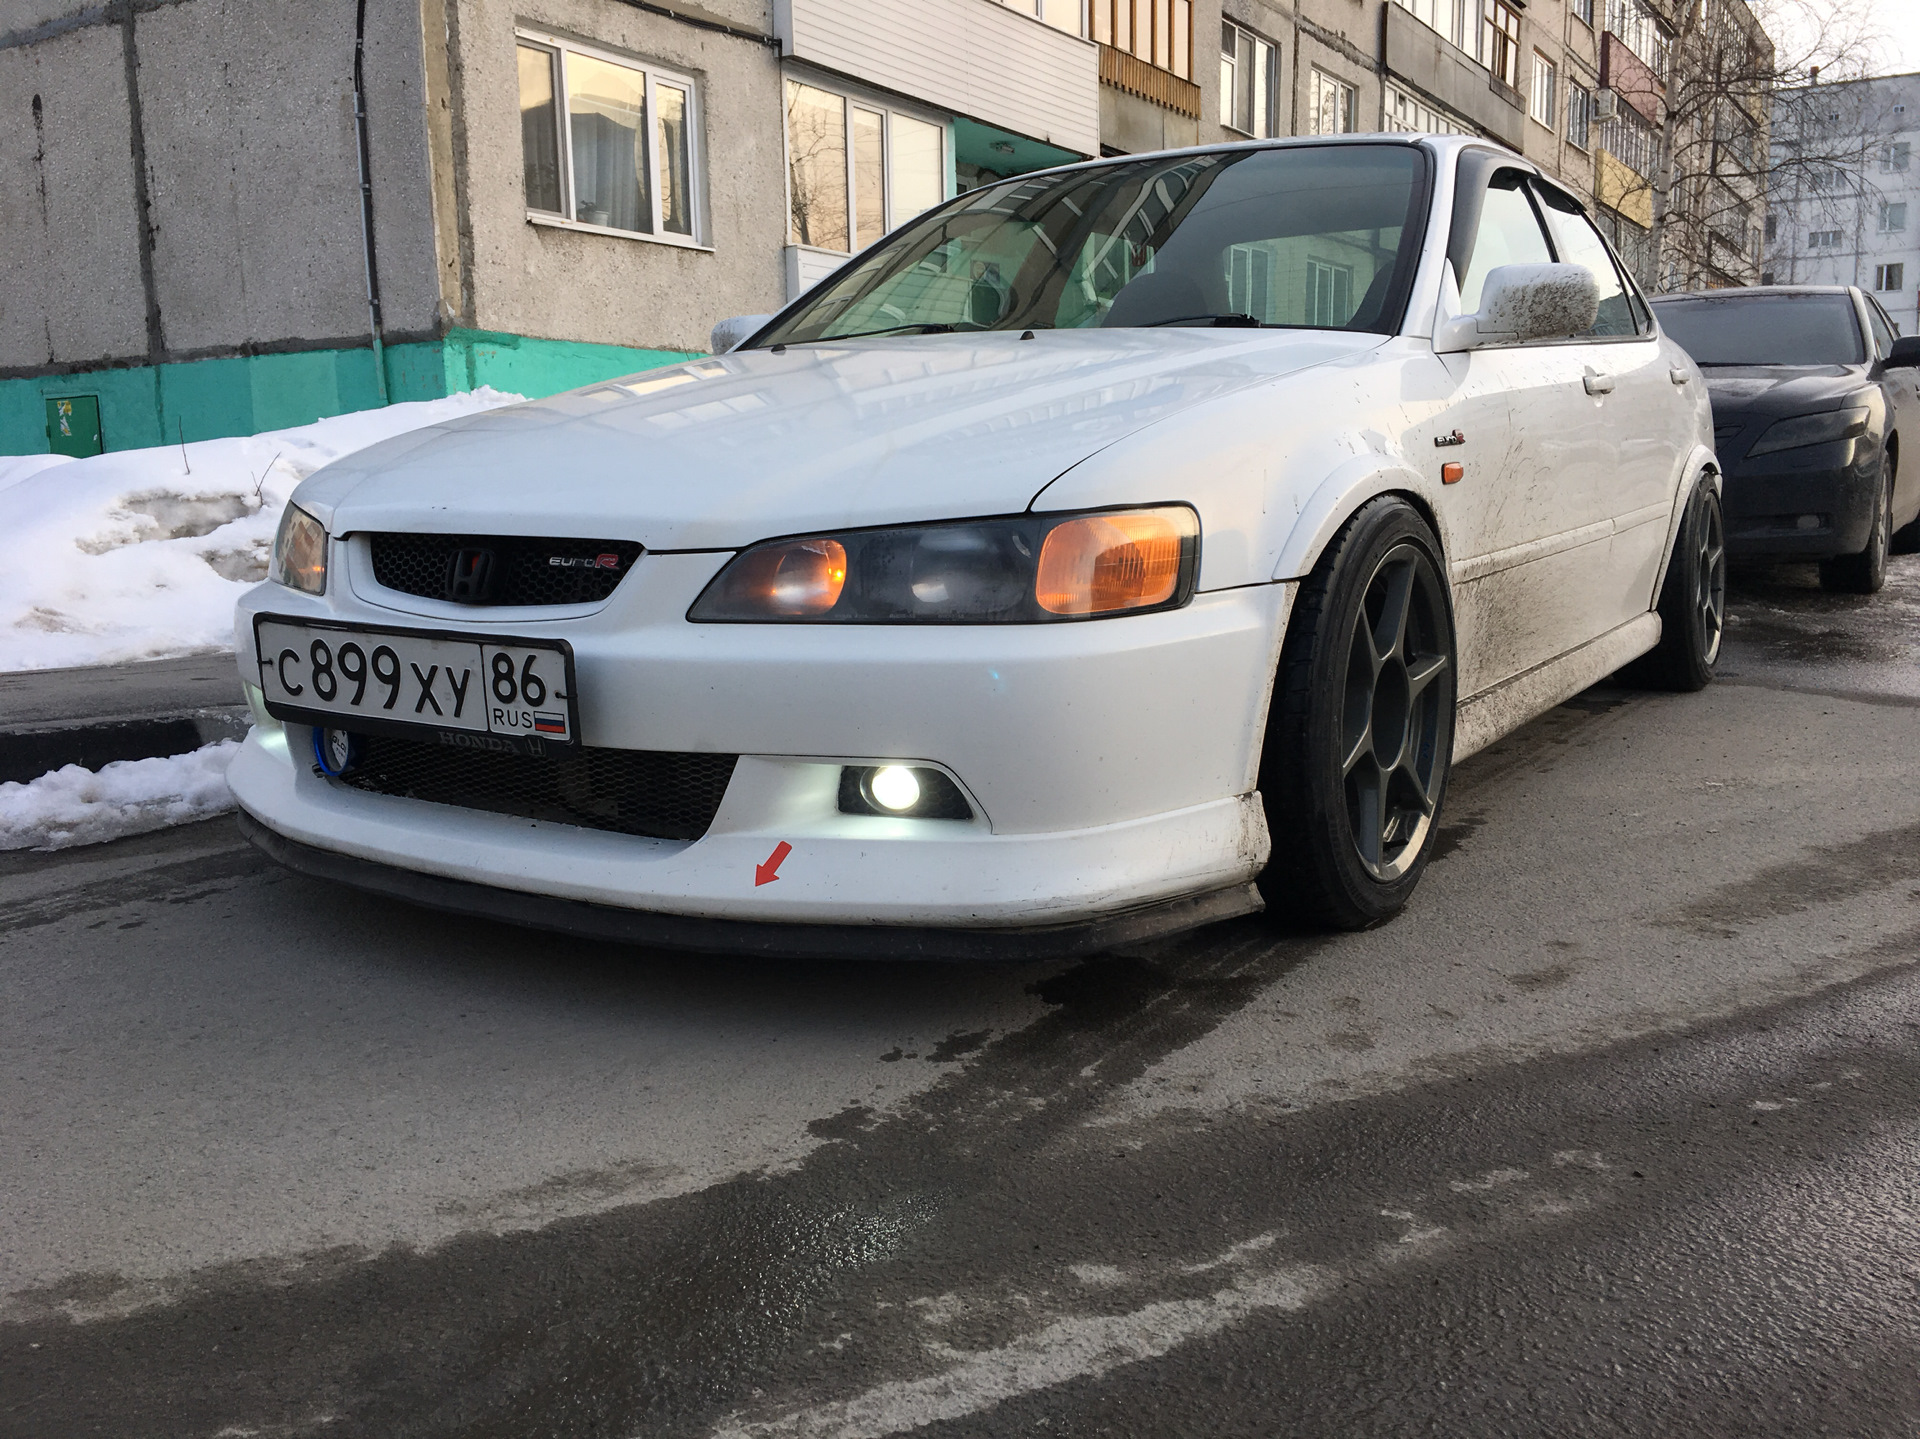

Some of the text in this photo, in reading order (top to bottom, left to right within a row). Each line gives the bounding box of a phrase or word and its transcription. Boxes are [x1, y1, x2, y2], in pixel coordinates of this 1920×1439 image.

[491, 652, 546, 707] 86
[493, 708, 533, 729] RUS
[439, 732, 519, 753] HONDA
